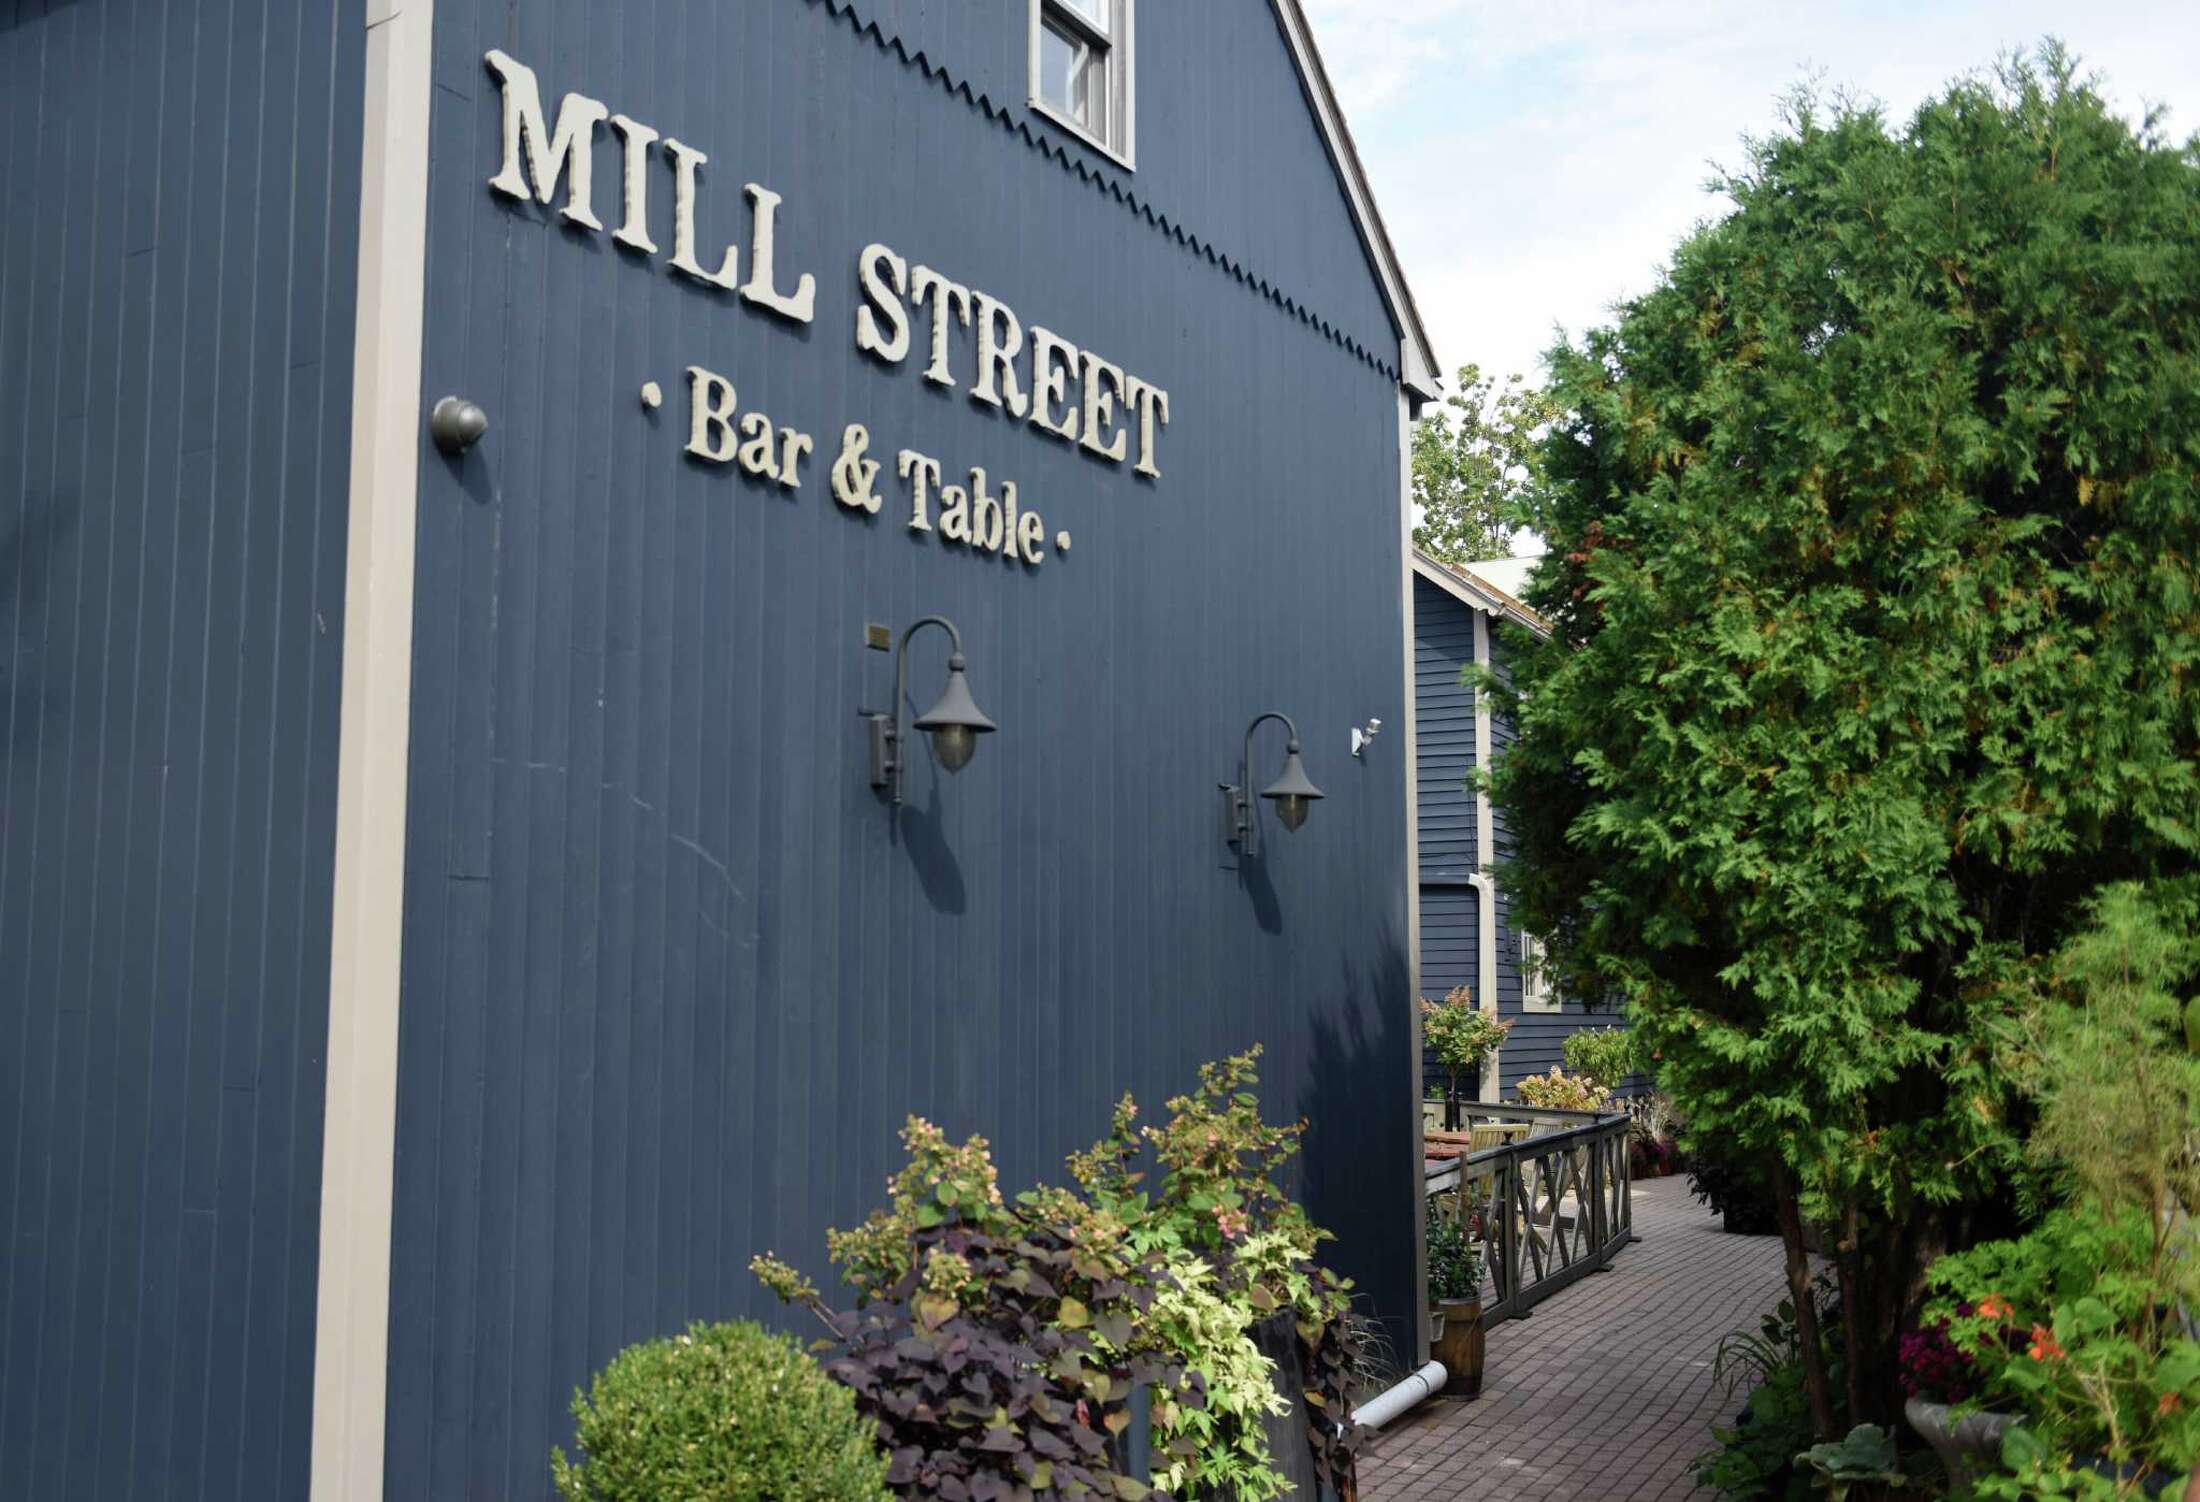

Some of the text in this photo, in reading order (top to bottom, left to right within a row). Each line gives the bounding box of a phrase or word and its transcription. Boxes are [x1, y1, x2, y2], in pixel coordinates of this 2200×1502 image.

[484, 49, 1170, 479] MILL STREET
[684, 365, 1045, 565] Bar & Table
